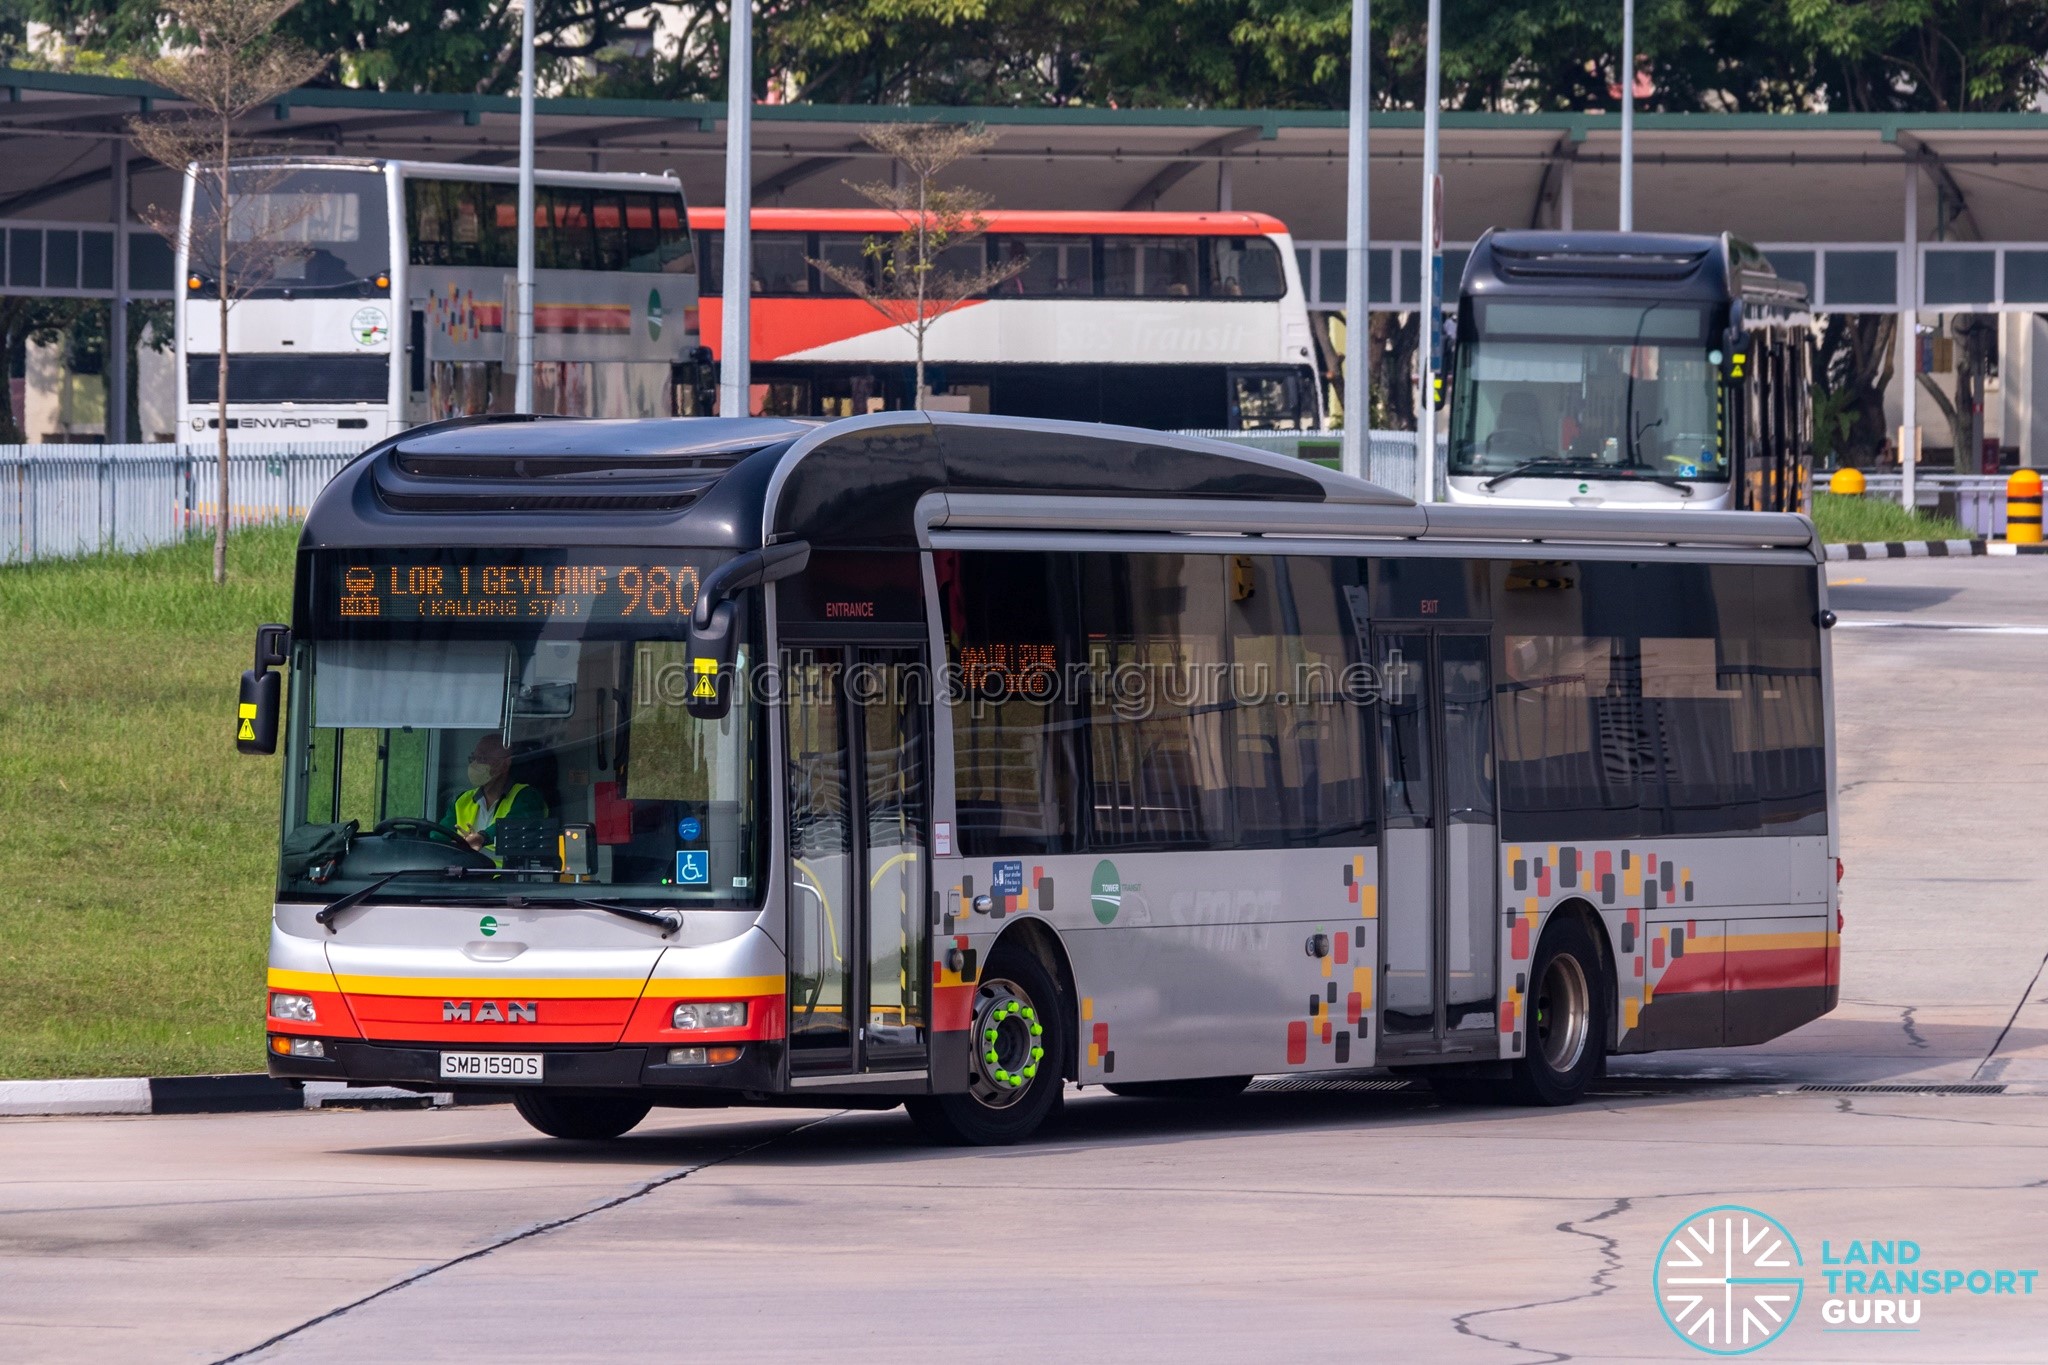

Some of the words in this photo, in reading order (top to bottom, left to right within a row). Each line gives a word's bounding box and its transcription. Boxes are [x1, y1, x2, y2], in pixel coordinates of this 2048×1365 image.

[1124, 313, 1248, 352] Transit
[391, 566, 443, 594] LOR
[460, 566, 469, 594] 1
[482, 566, 607, 594] GEYLANG
[618, 566, 699, 616] 980
[418, 600, 517, 616] (KALLANG
[528, 600, 579, 616] STN)
[826, 602, 874, 617] ENTRANCE
[1421, 600, 1438, 613] EXIT
[1102, 883, 1119, 892] TOWER
[1121, 883, 1141, 892] TRANSIT
[443, 1001, 539, 1023] MAN
[446, 1056, 537, 1075] SMB1590S
